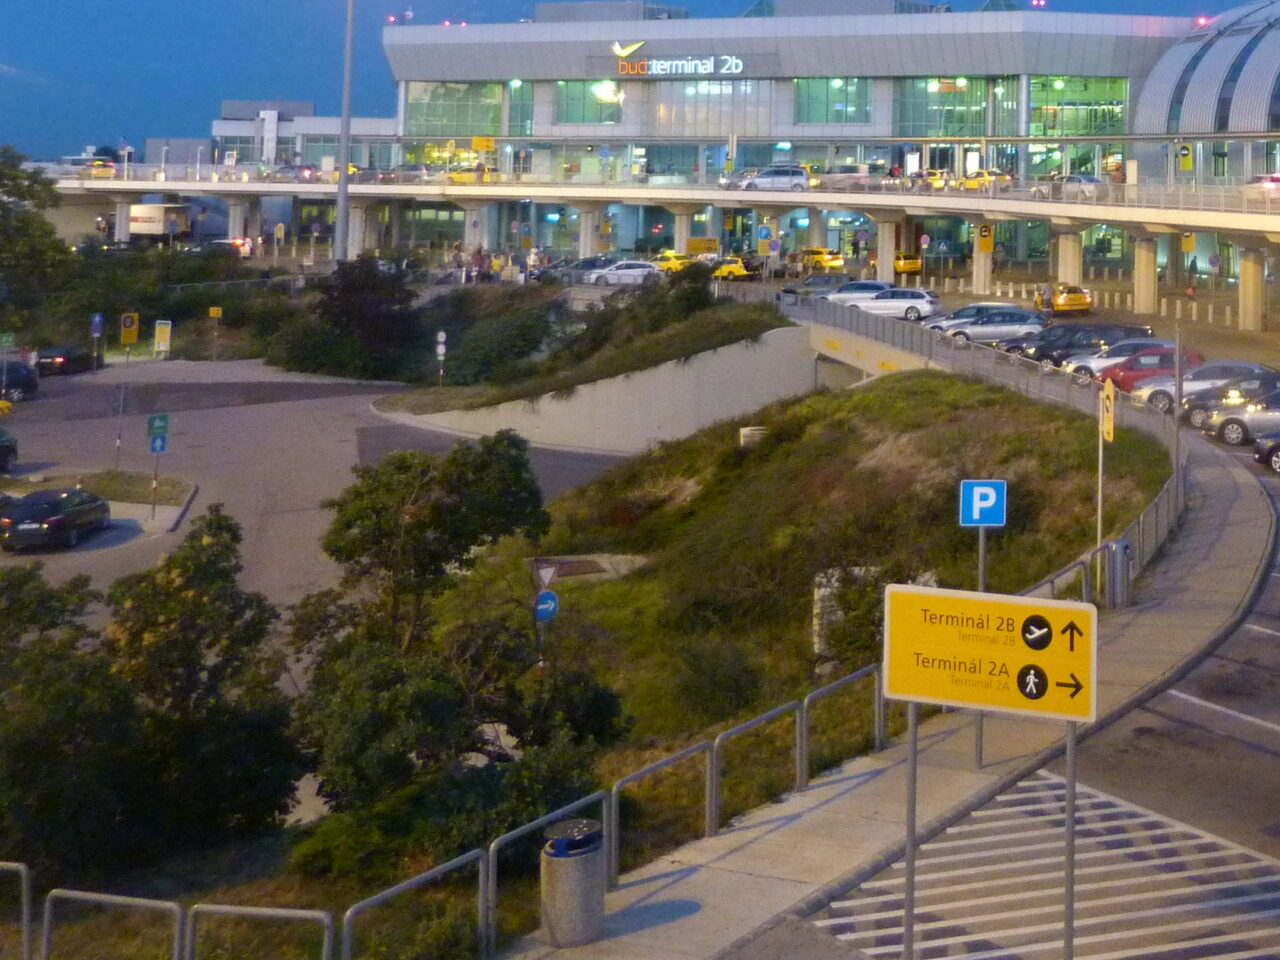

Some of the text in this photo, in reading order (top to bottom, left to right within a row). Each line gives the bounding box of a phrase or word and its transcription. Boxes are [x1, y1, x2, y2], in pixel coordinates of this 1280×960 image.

[719, 56, 743, 74] 2b
[972, 486, 997, 520] P
[921, 608, 1015, 632] Terminál 2B
[913, 652, 1010, 677] Terminál 2A
